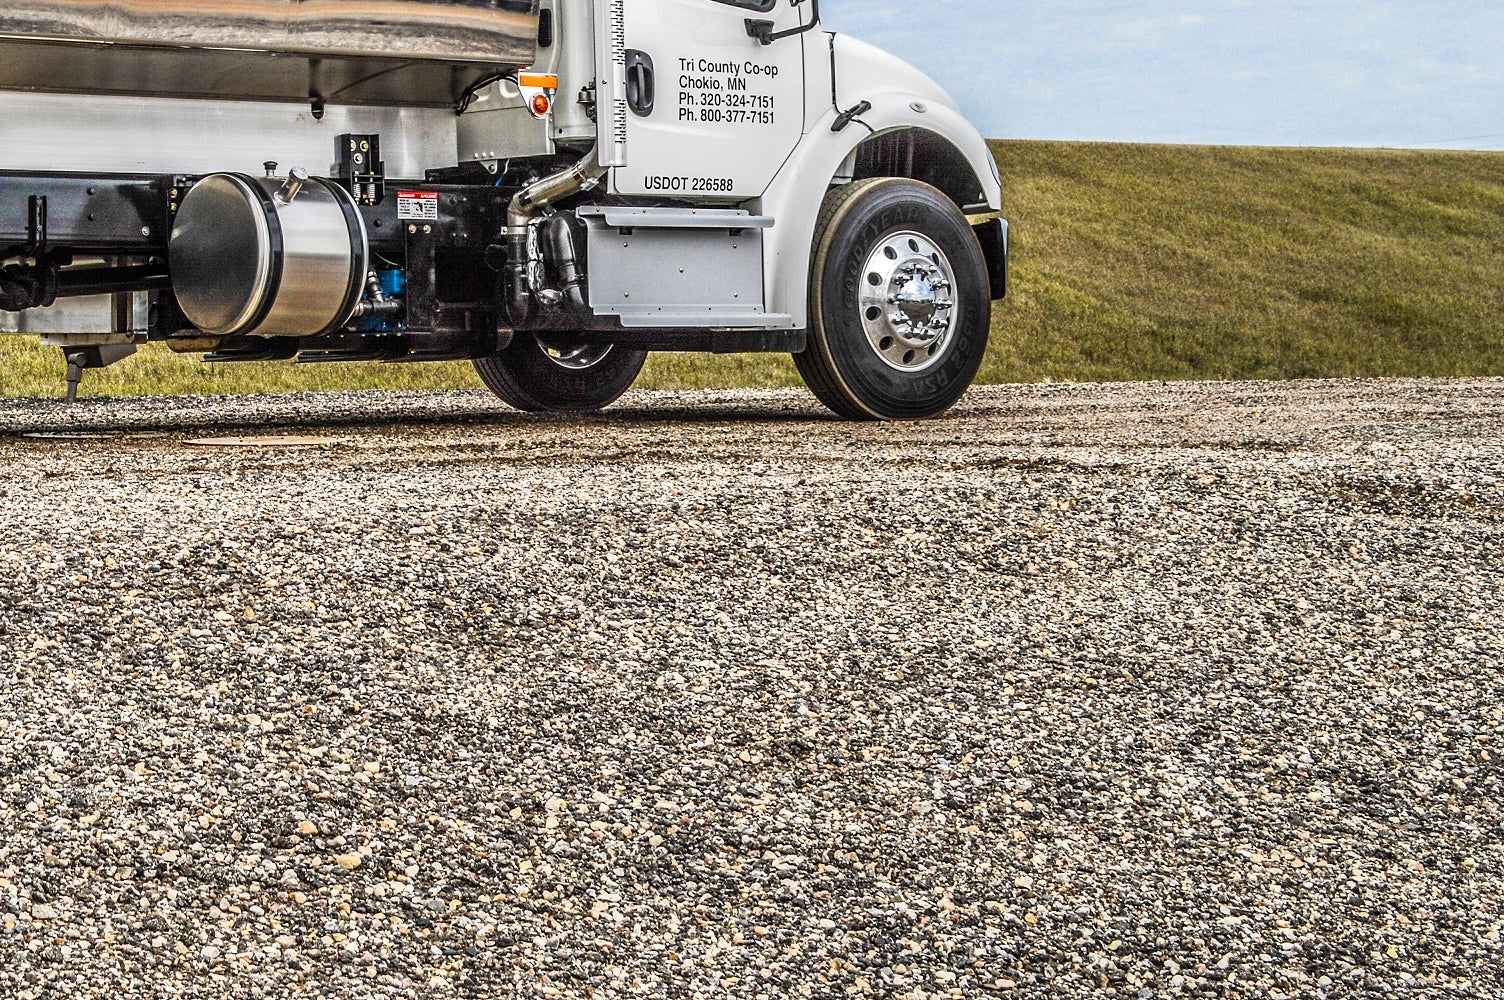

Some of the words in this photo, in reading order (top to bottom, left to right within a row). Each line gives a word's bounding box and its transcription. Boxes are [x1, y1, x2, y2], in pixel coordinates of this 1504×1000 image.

[678, 58, 695, 71] Tri
[698, 59, 740, 77] County
[744, 61, 778, 79] Co-op
[679, 75, 724, 91] Chokio,
[727, 77, 746, 91] MN
[679, 92, 698, 105] Ph.
[700, 92, 774, 108] 320-324-7151
[679, 107, 697, 121] Ph.
[700, 108, 774, 124] 800-377-7151
[644, 176, 689, 190] USDOT
[691, 177, 733, 191] 226588
